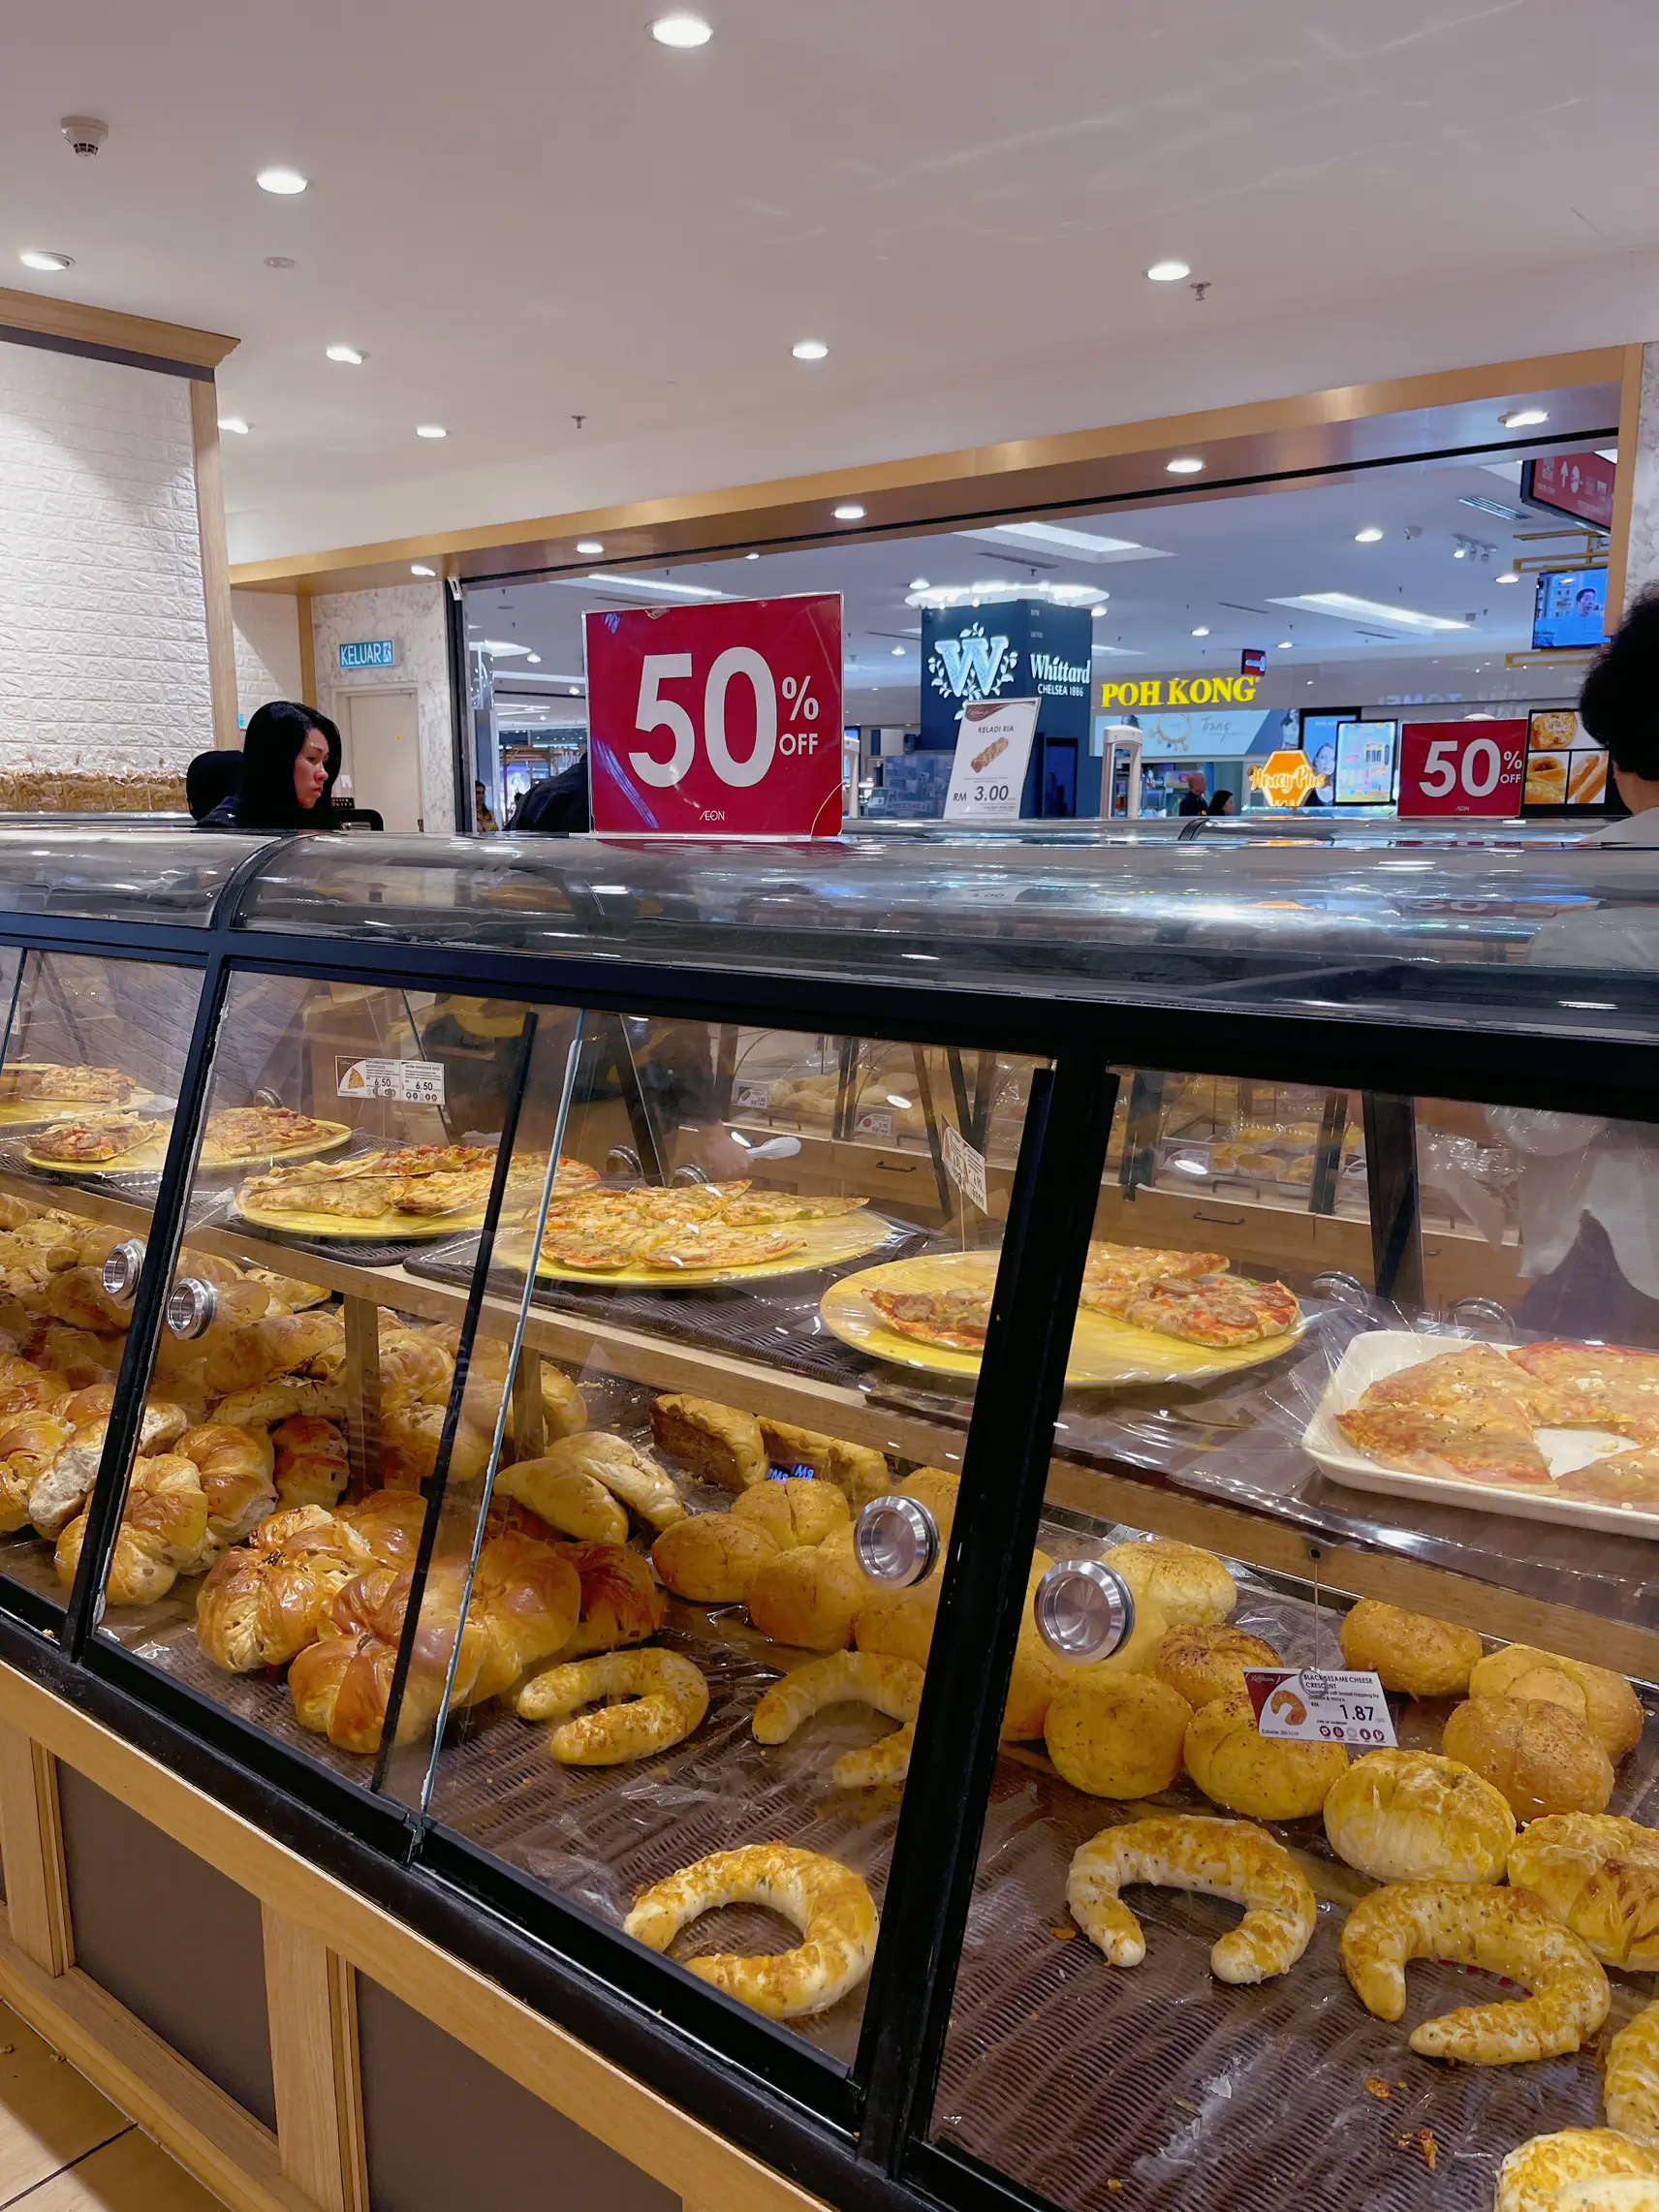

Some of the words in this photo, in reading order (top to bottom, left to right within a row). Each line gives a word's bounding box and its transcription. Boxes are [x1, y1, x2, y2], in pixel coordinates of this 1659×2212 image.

[340, 643, 382, 667] KELUAR
[1029, 653, 1091, 684] Whittard
[1037, 683, 1068, 696] CHELSEA
[1101, 680, 1162, 708] POH
[1166, 676, 1257, 705] KONG
[779, 733, 819, 756] OFF
[1500, 773, 1521, 784] OFF
[953, 793, 967, 802] RM
[974, 785, 1010, 801] 3.00
[374, 1078, 391, 1087] 6.50
[416, 1081, 433, 1091] 6.50
[1339, 1704, 1374, 1722] 1.87
